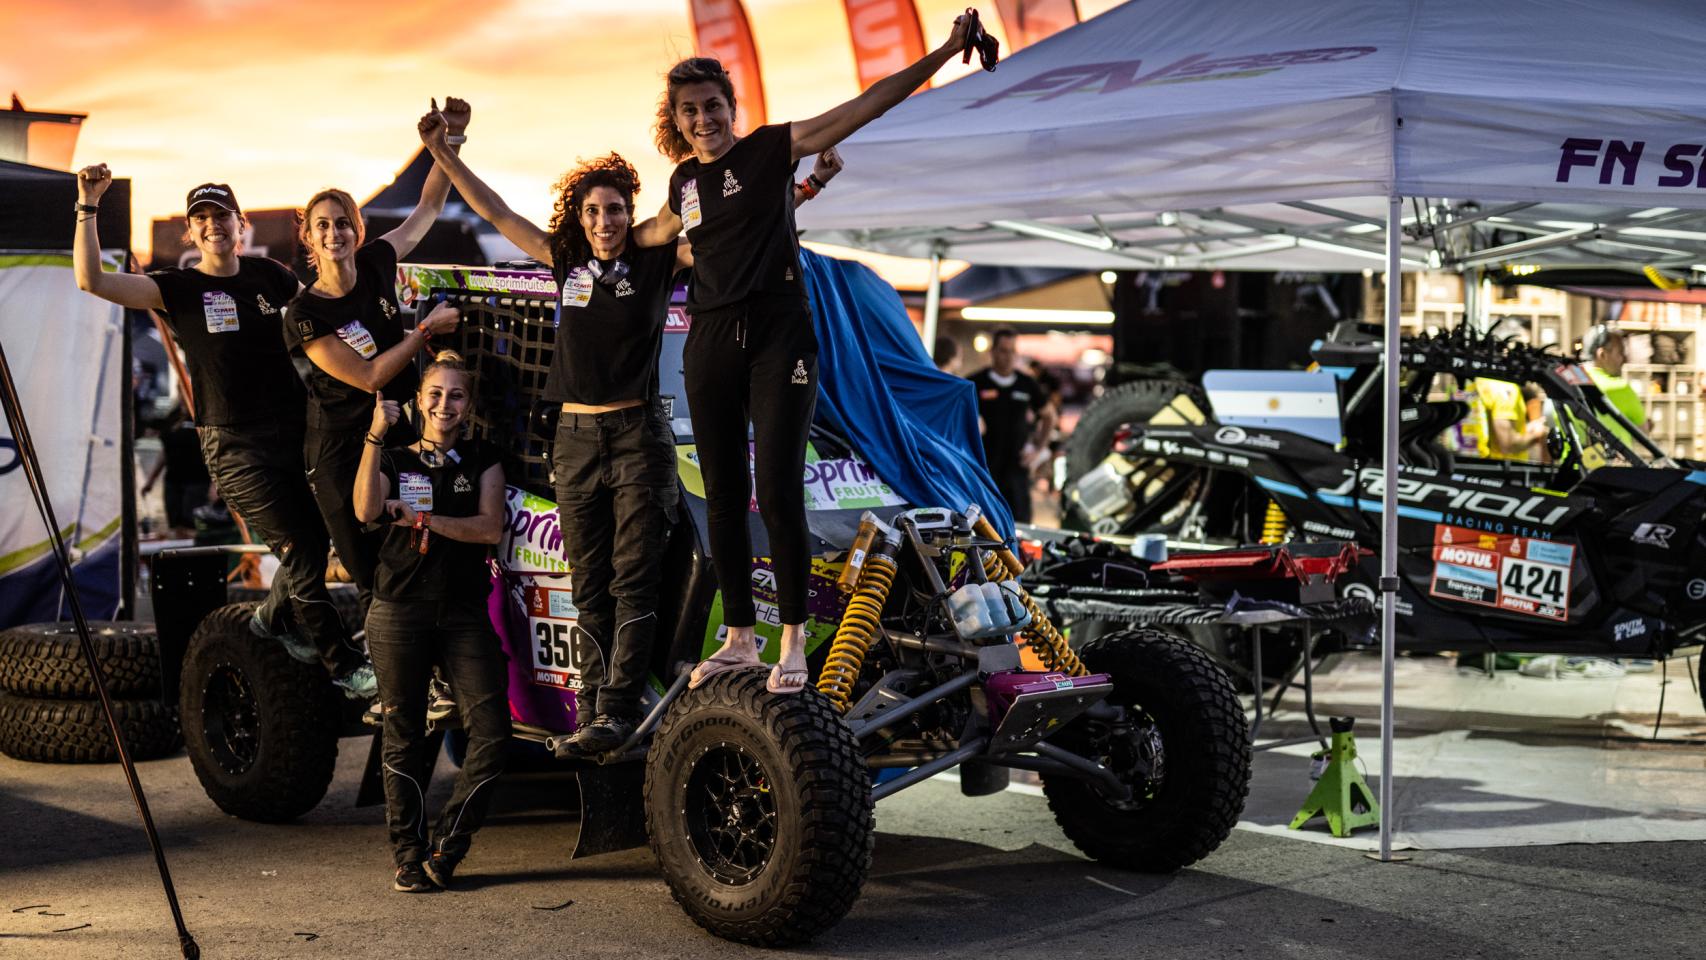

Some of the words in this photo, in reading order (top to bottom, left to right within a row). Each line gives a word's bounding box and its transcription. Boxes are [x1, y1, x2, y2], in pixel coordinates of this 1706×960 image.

[1556, 138, 1645, 186] FN
[470, 275, 557, 293] www.sprimfruits.es
[1446, 513, 1504, 533] RACING
[1512, 525, 1552, 541] TEAM
[1440, 546, 1492, 569] MOTUL
[1504, 563, 1564, 603] 424
[1503, 597, 1534, 611] MOTUL
[536, 671, 564, 685] MOTUL
